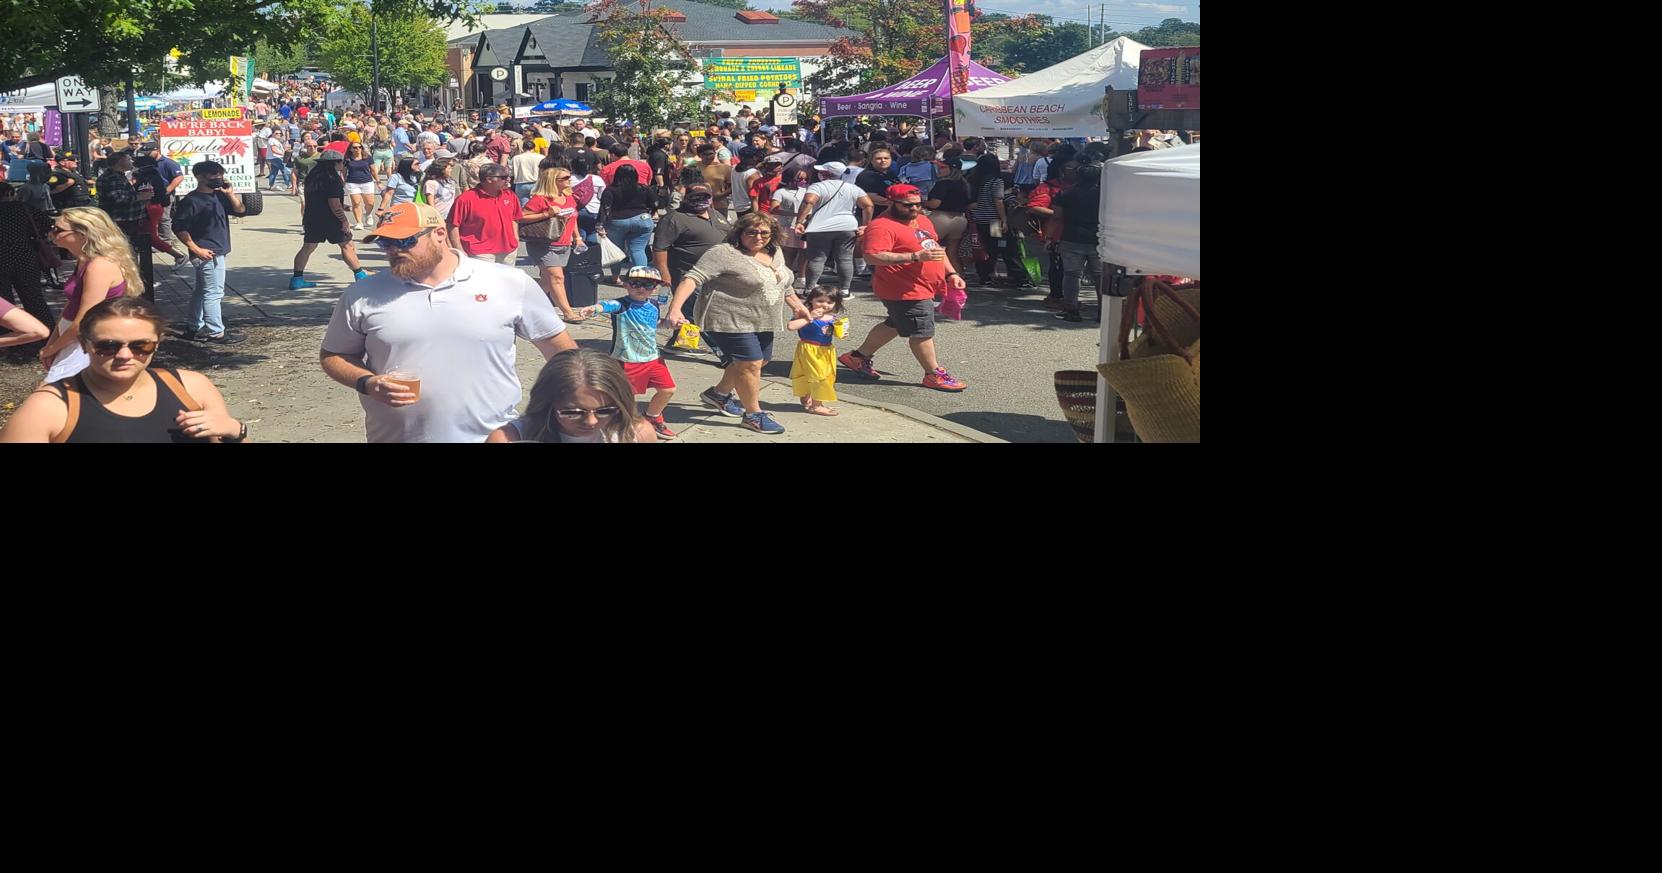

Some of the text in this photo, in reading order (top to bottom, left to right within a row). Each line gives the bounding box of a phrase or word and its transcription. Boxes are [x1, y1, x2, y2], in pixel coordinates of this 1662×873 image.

[737, 74, 759, 82] FRIED
[760, 73, 798, 81] POTATOES
[63, 86, 93, 97] WAY
[837, 101, 908, 112] Beer Sangria Wine
[980, 103, 1066, 114] CARIBBEAN BEACH
[203, 109, 241, 119] LEMONADE
[166, 121, 206, 129] WE'RE
[994, 115, 1051, 125] SMOOTHIES
[164, 138, 245, 156] Duluth
[204, 154, 237, 165] Fall
